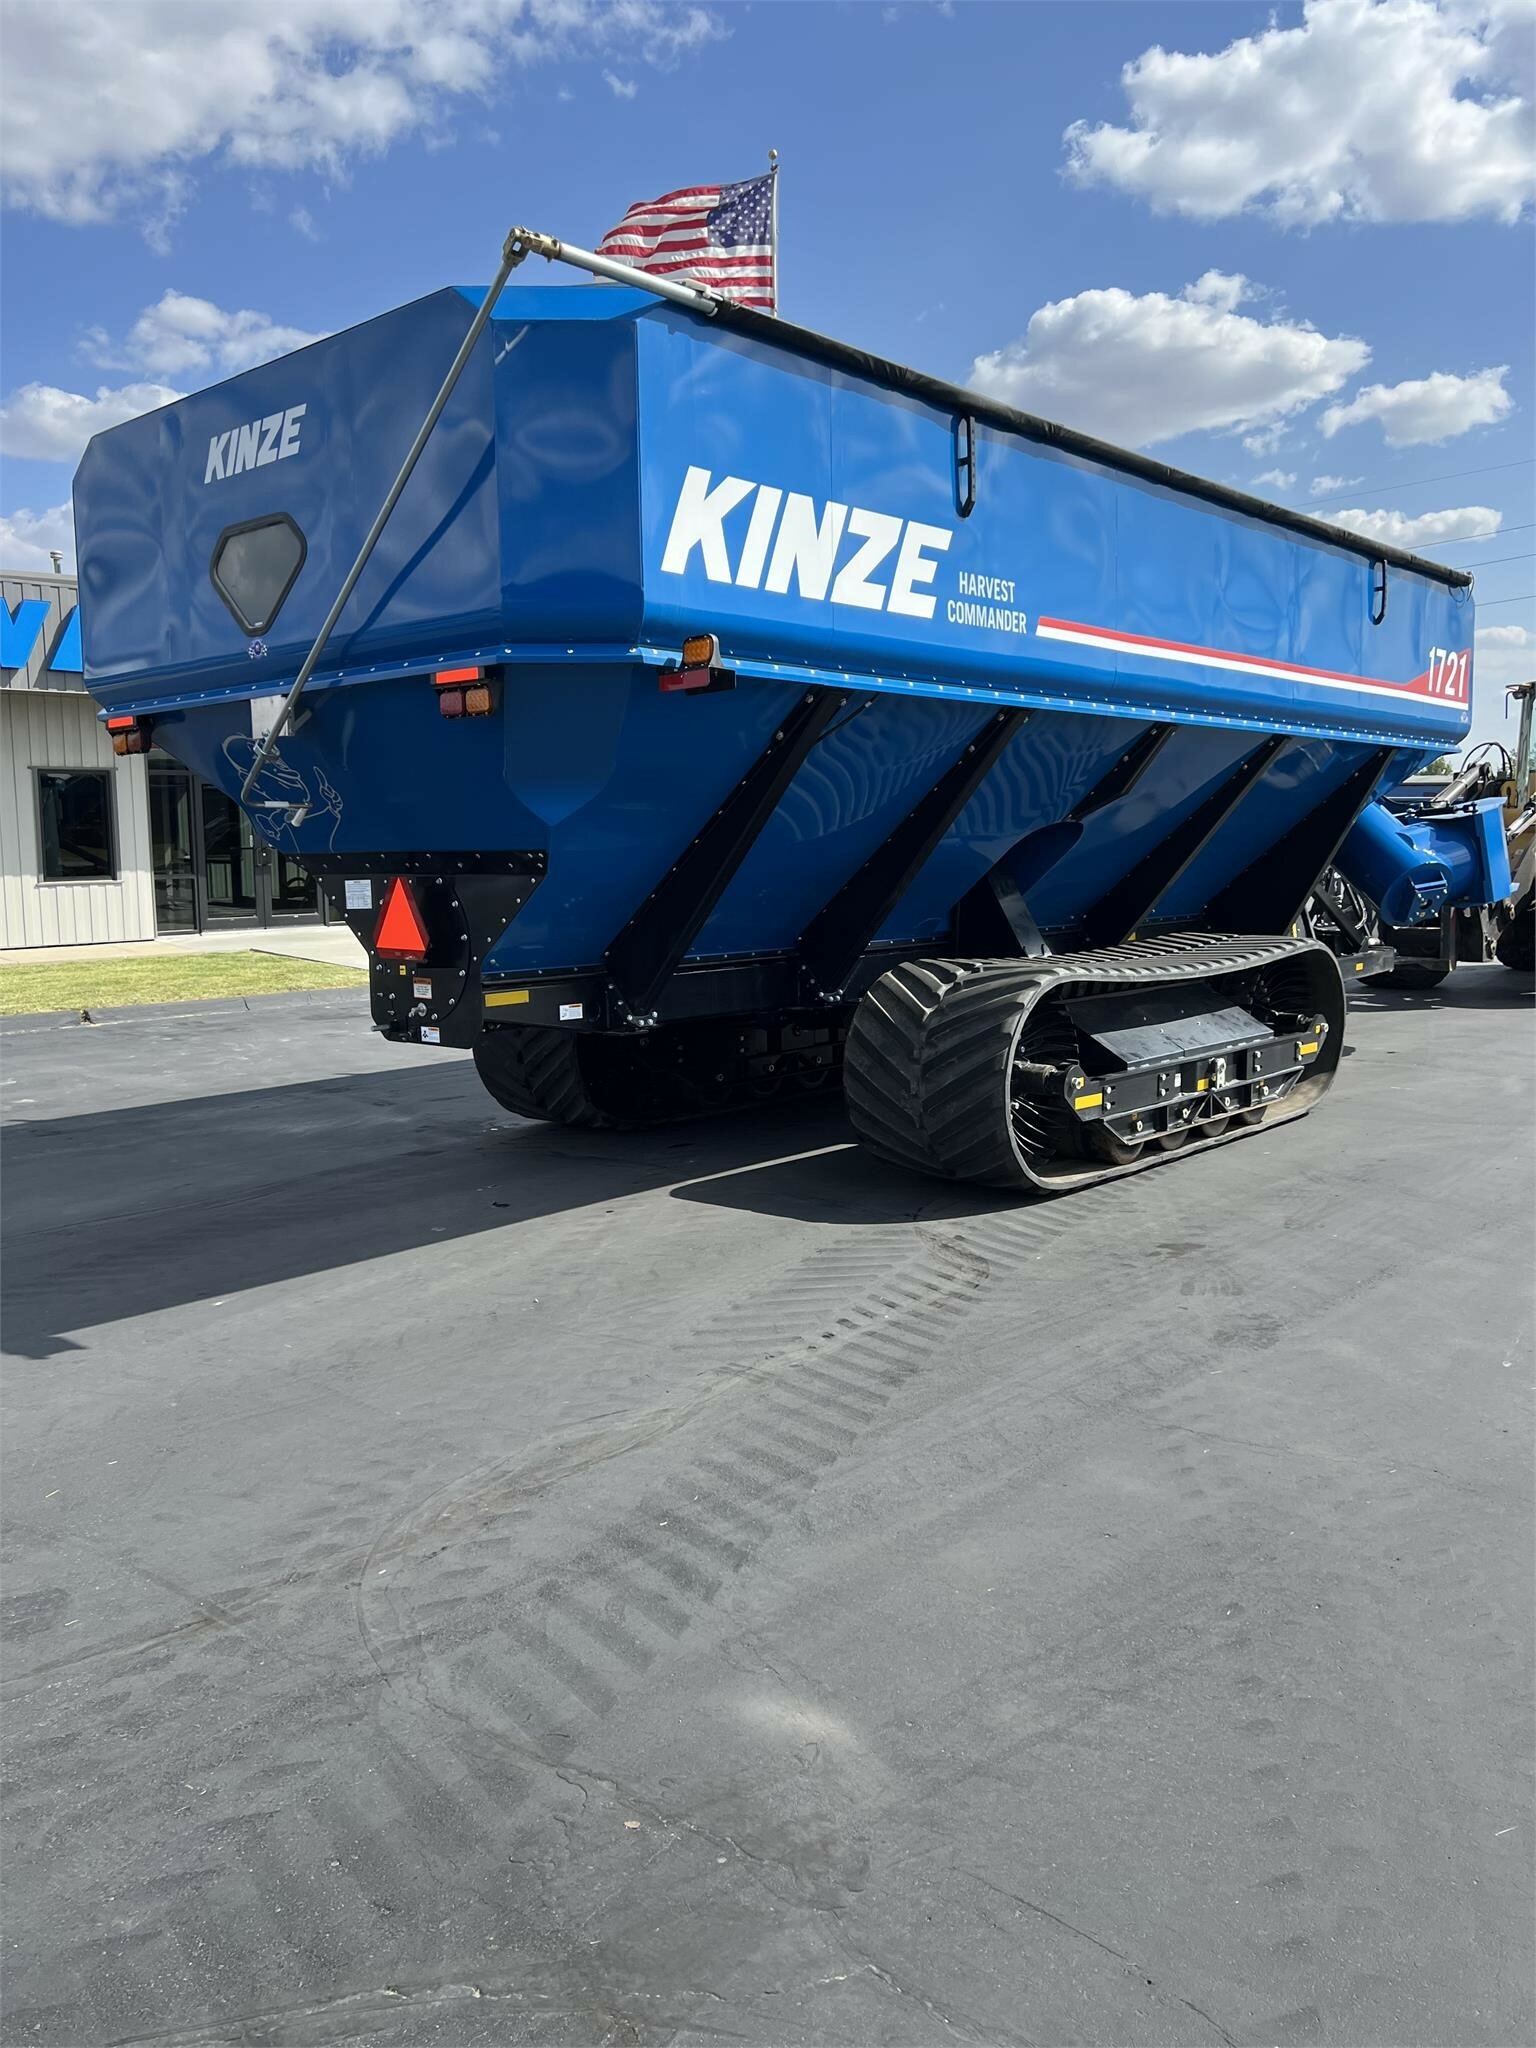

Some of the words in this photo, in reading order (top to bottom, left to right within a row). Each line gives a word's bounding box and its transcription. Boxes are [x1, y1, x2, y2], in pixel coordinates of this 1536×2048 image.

[204, 403, 307, 484] KINZE
[661, 465, 953, 619] KINZE
[959, 571, 1015, 603] HARVEST
[947, 599, 1027, 634] COMMANDER
[1428, 646, 1467, 698] 1721
